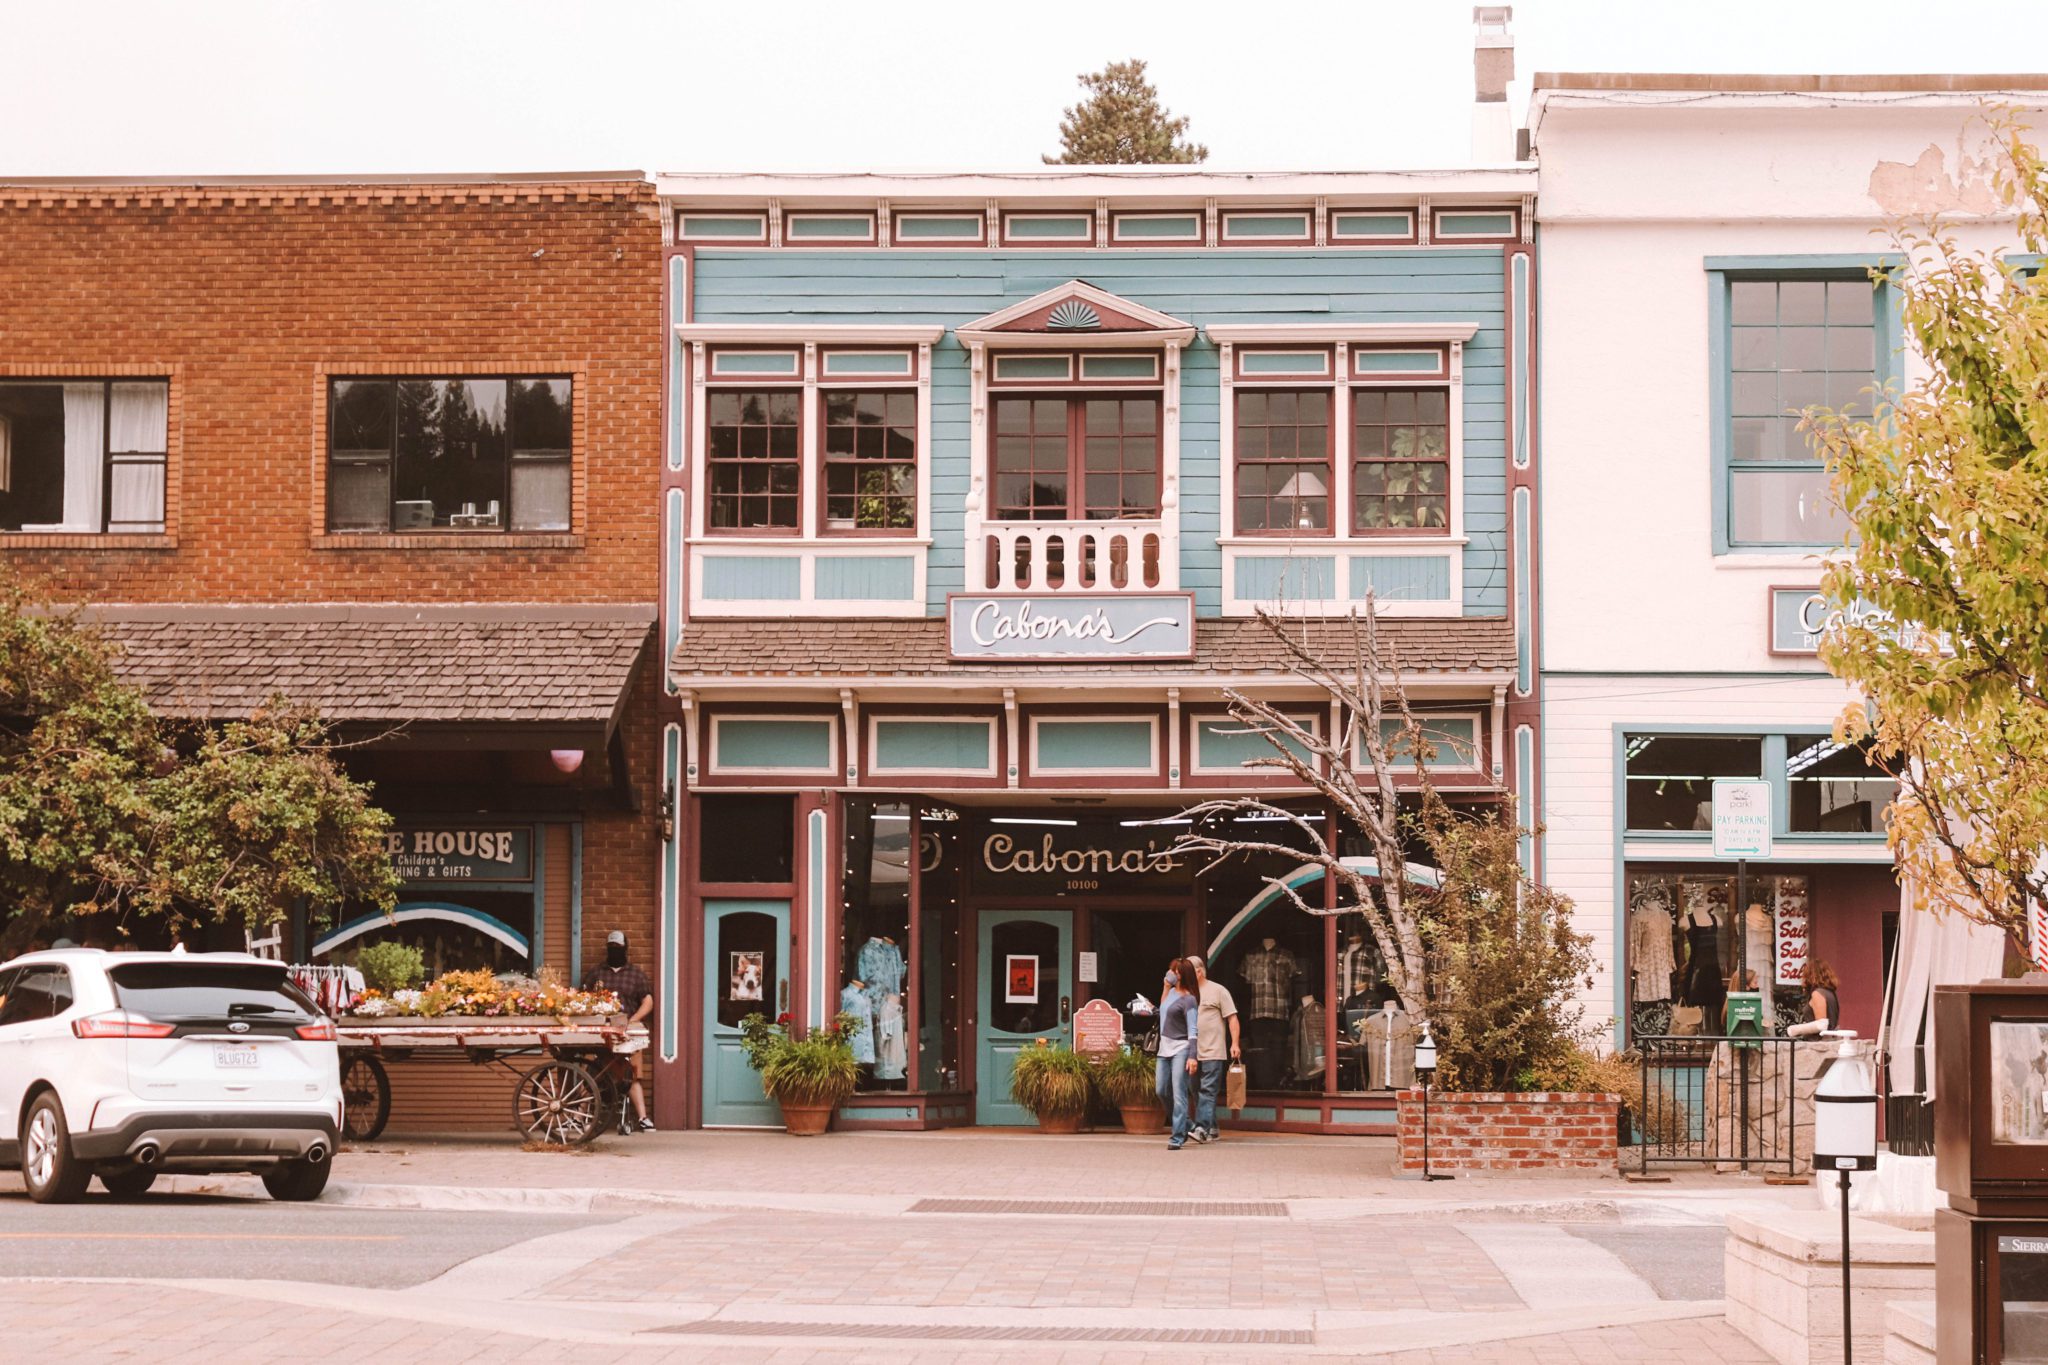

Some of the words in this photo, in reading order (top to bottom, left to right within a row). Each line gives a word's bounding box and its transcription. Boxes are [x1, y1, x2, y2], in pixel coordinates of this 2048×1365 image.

[970, 600, 1179, 647] Cabona's
[1717, 815, 1731, 825] PAY
[1735, 815, 1767, 825] PARKING
[414, 831, 514, 864] HOUSE
[983, 833, 1184, 873] Cabona's
[397, 854, 445, 865] Children's
[427, 866, 435, 877] &
[442, 865, 471, 877] GIFTS
[1066, 880, 1098, 890] 10100
[1780, 962, 1807, 980] Sal
